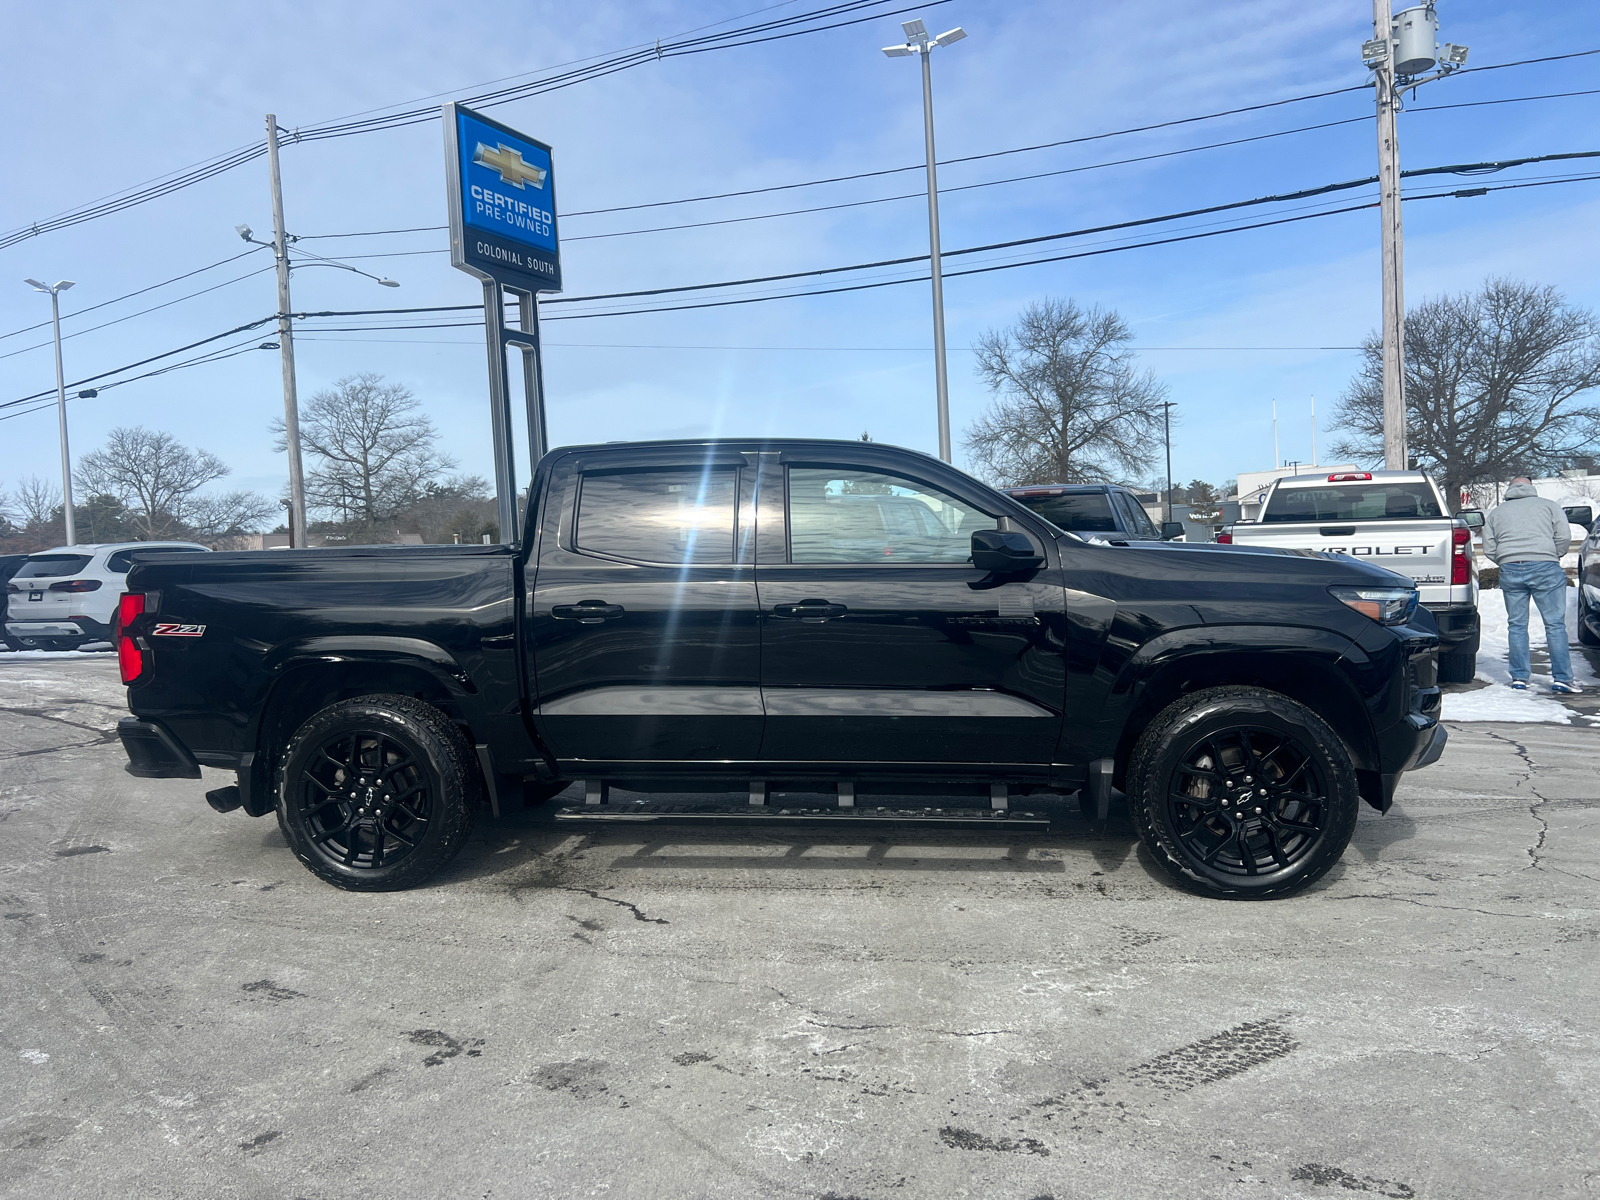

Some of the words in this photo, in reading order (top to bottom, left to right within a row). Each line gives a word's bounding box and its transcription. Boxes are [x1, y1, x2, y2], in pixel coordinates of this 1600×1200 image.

[471, 185, 552, 225] CERTIFIED
[476, 201, 550, 237] PRE-OWNED
[477, 241, 523, 266] COLONIAL
[527, 256, 554, 275] SOUTH
[1306, 545, 1435, 556] ROLET
[152, 623, 207, 637] Z71
